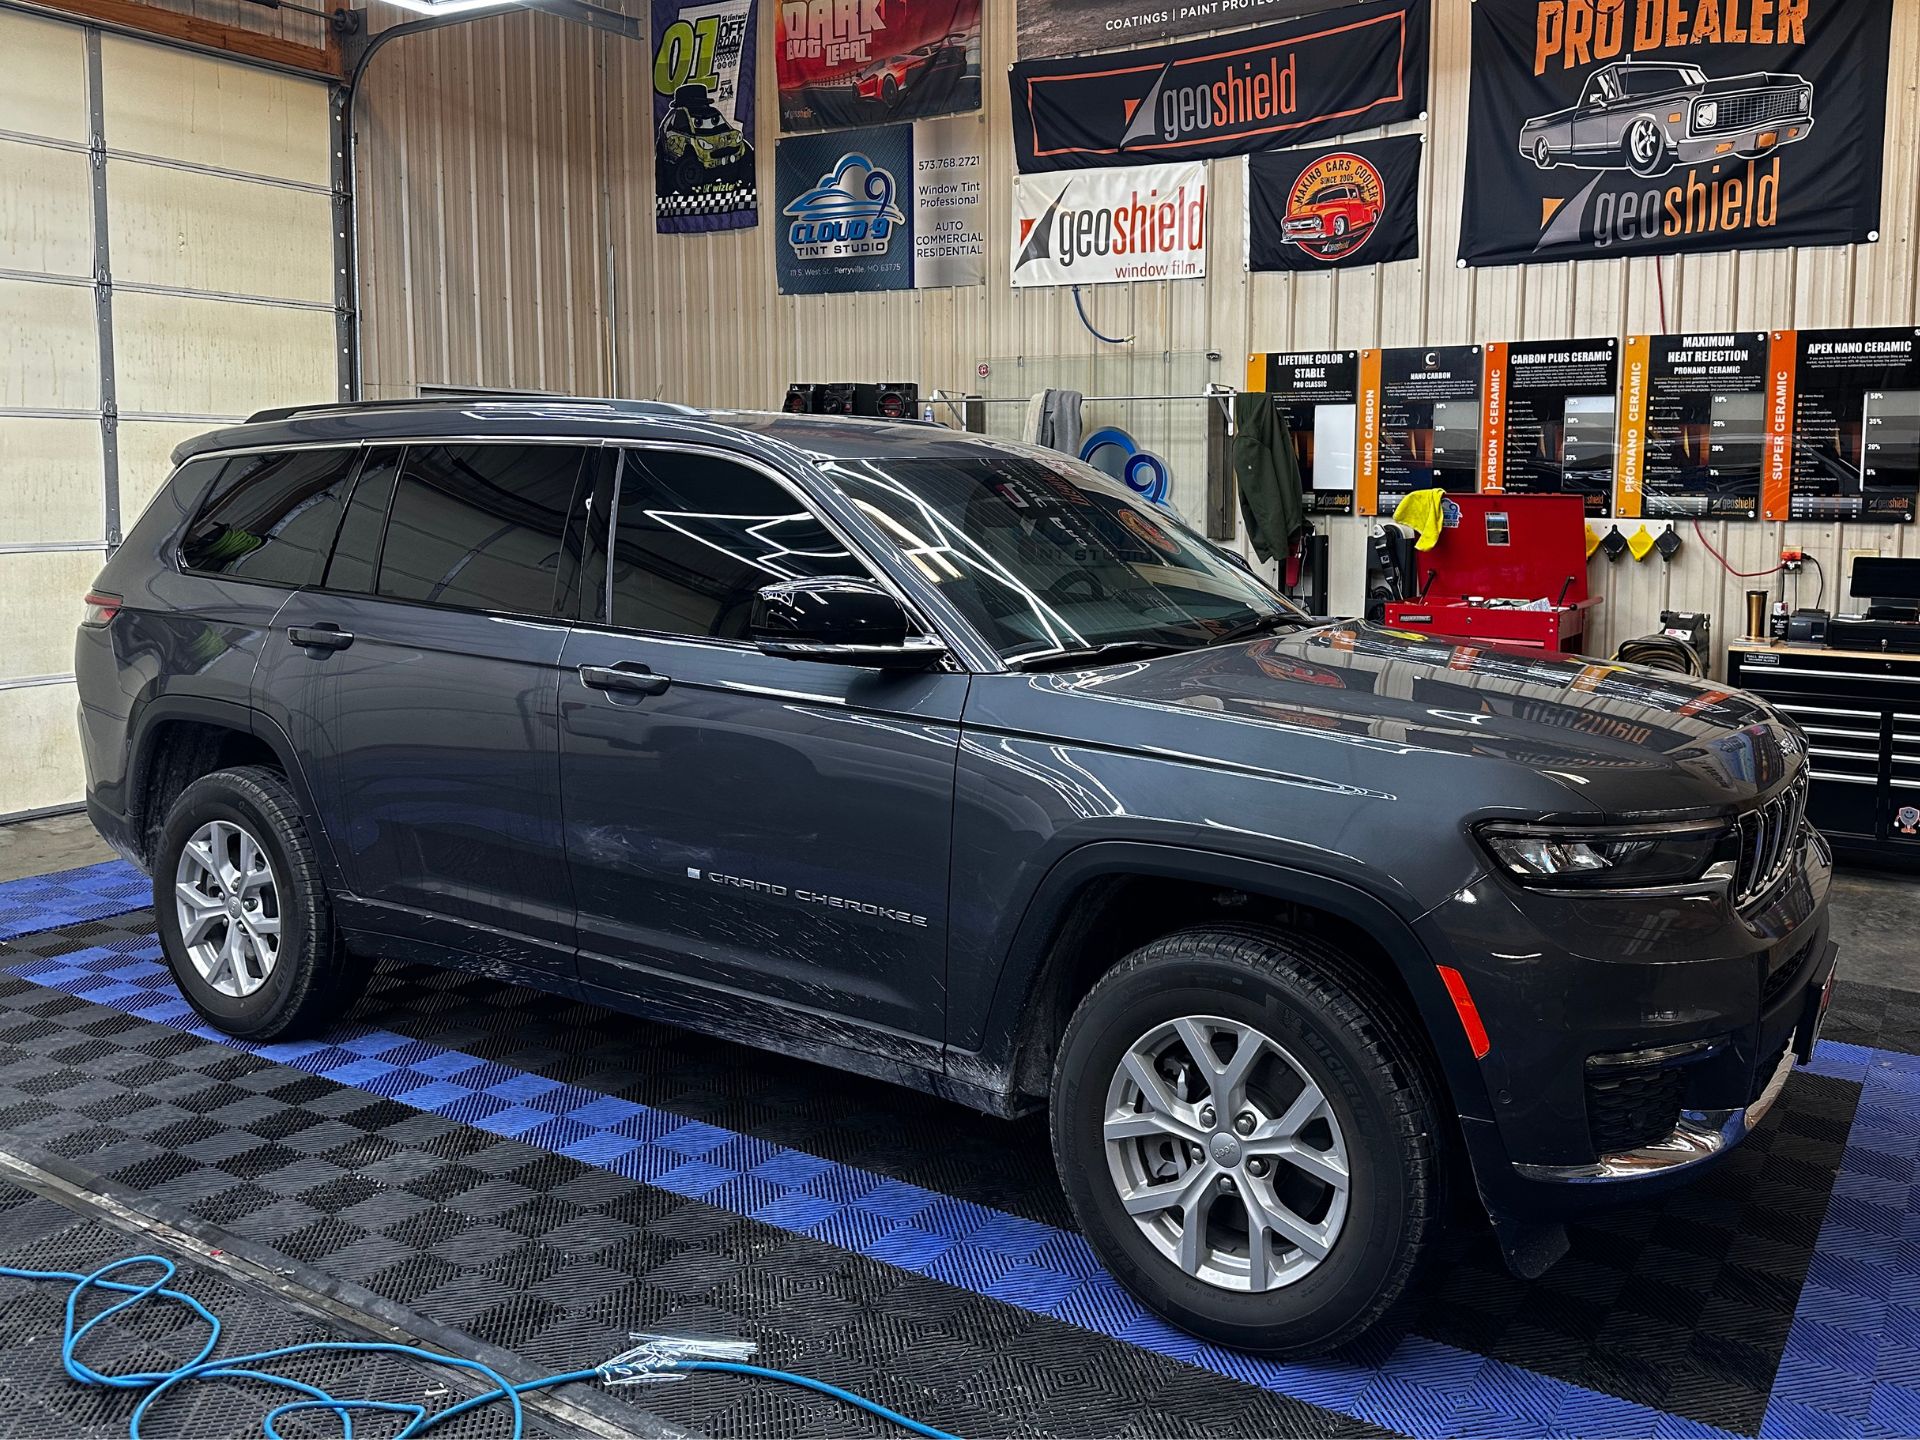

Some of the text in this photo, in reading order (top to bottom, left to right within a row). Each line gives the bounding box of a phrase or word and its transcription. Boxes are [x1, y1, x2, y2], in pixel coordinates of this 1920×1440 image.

[1106, 11, 1168, 31] COATINGS
[1180, 3, 1218, 19] PAINT
[721, 20, 745, 38] OFF
[1533, 0, 1806, 77] PRO DEALER
[654, 15, 720, 95] 01
[787, 39, 820, 60] BUT
[826, 40, 872, 66] LEGAL
[1163, 53, 1297, 141] geoshield
[919, 155, 980, 171] 573.768.2721
[1326, 160, 1351, 172] CARS
[1355, 165, 1379, 200] COOLER
[919, 182, 980, 196] Window Tint
[920, 194, 979, 208] Professional
[1593, 156, 1781, 248] geoshield
[791, 217, 889, 244] CLOUD 9
[935, 221, 963, 232] AUTO
[1059, 185, 1206, 268] geoshield
[916, 232, 984, 246] COMMERCIAL
[797, 242, 885, 257] TINT STUDIO
[916, 245, 983, 258] RESIDENTIAL
[1115, 261, 1196, 279] window film
[1682, 335, 1735, 348] MAXIMUM
[1807, 340, 1912, 354] APEX NANO CERAMIC
[1278, 353, 1343, 366] LIFETIME COLOR
[1511, 350, 1612, 365] CARBON PLUS CERAMIC
[1667, 350, 1748, 363] HEAT REJECTION
[1294, 367, 1325, 379] STABLE
[1426, 371, 1451, 380] CARBON
[1673, 365, 1741, 375] PRONANO CERAMIC
[1304, 380, 1327, 388] CLASSIC
[1489, 369, 1501, 425] CERAMIC
[1363, 389, 1375, 476] NANO CARBON
[1625, 361, 1642, 493] PRONANO CERAMIC
[1772, 371, 1788, 480] SUPER CERAMIC
[1486, 439, 1498, 489] CARBON
[1866, 468, 1876, 476] 5%
[1722, 497, 1755, 510] geoshield
[708, 871, 928, 927] GRAND CHEROKEE
